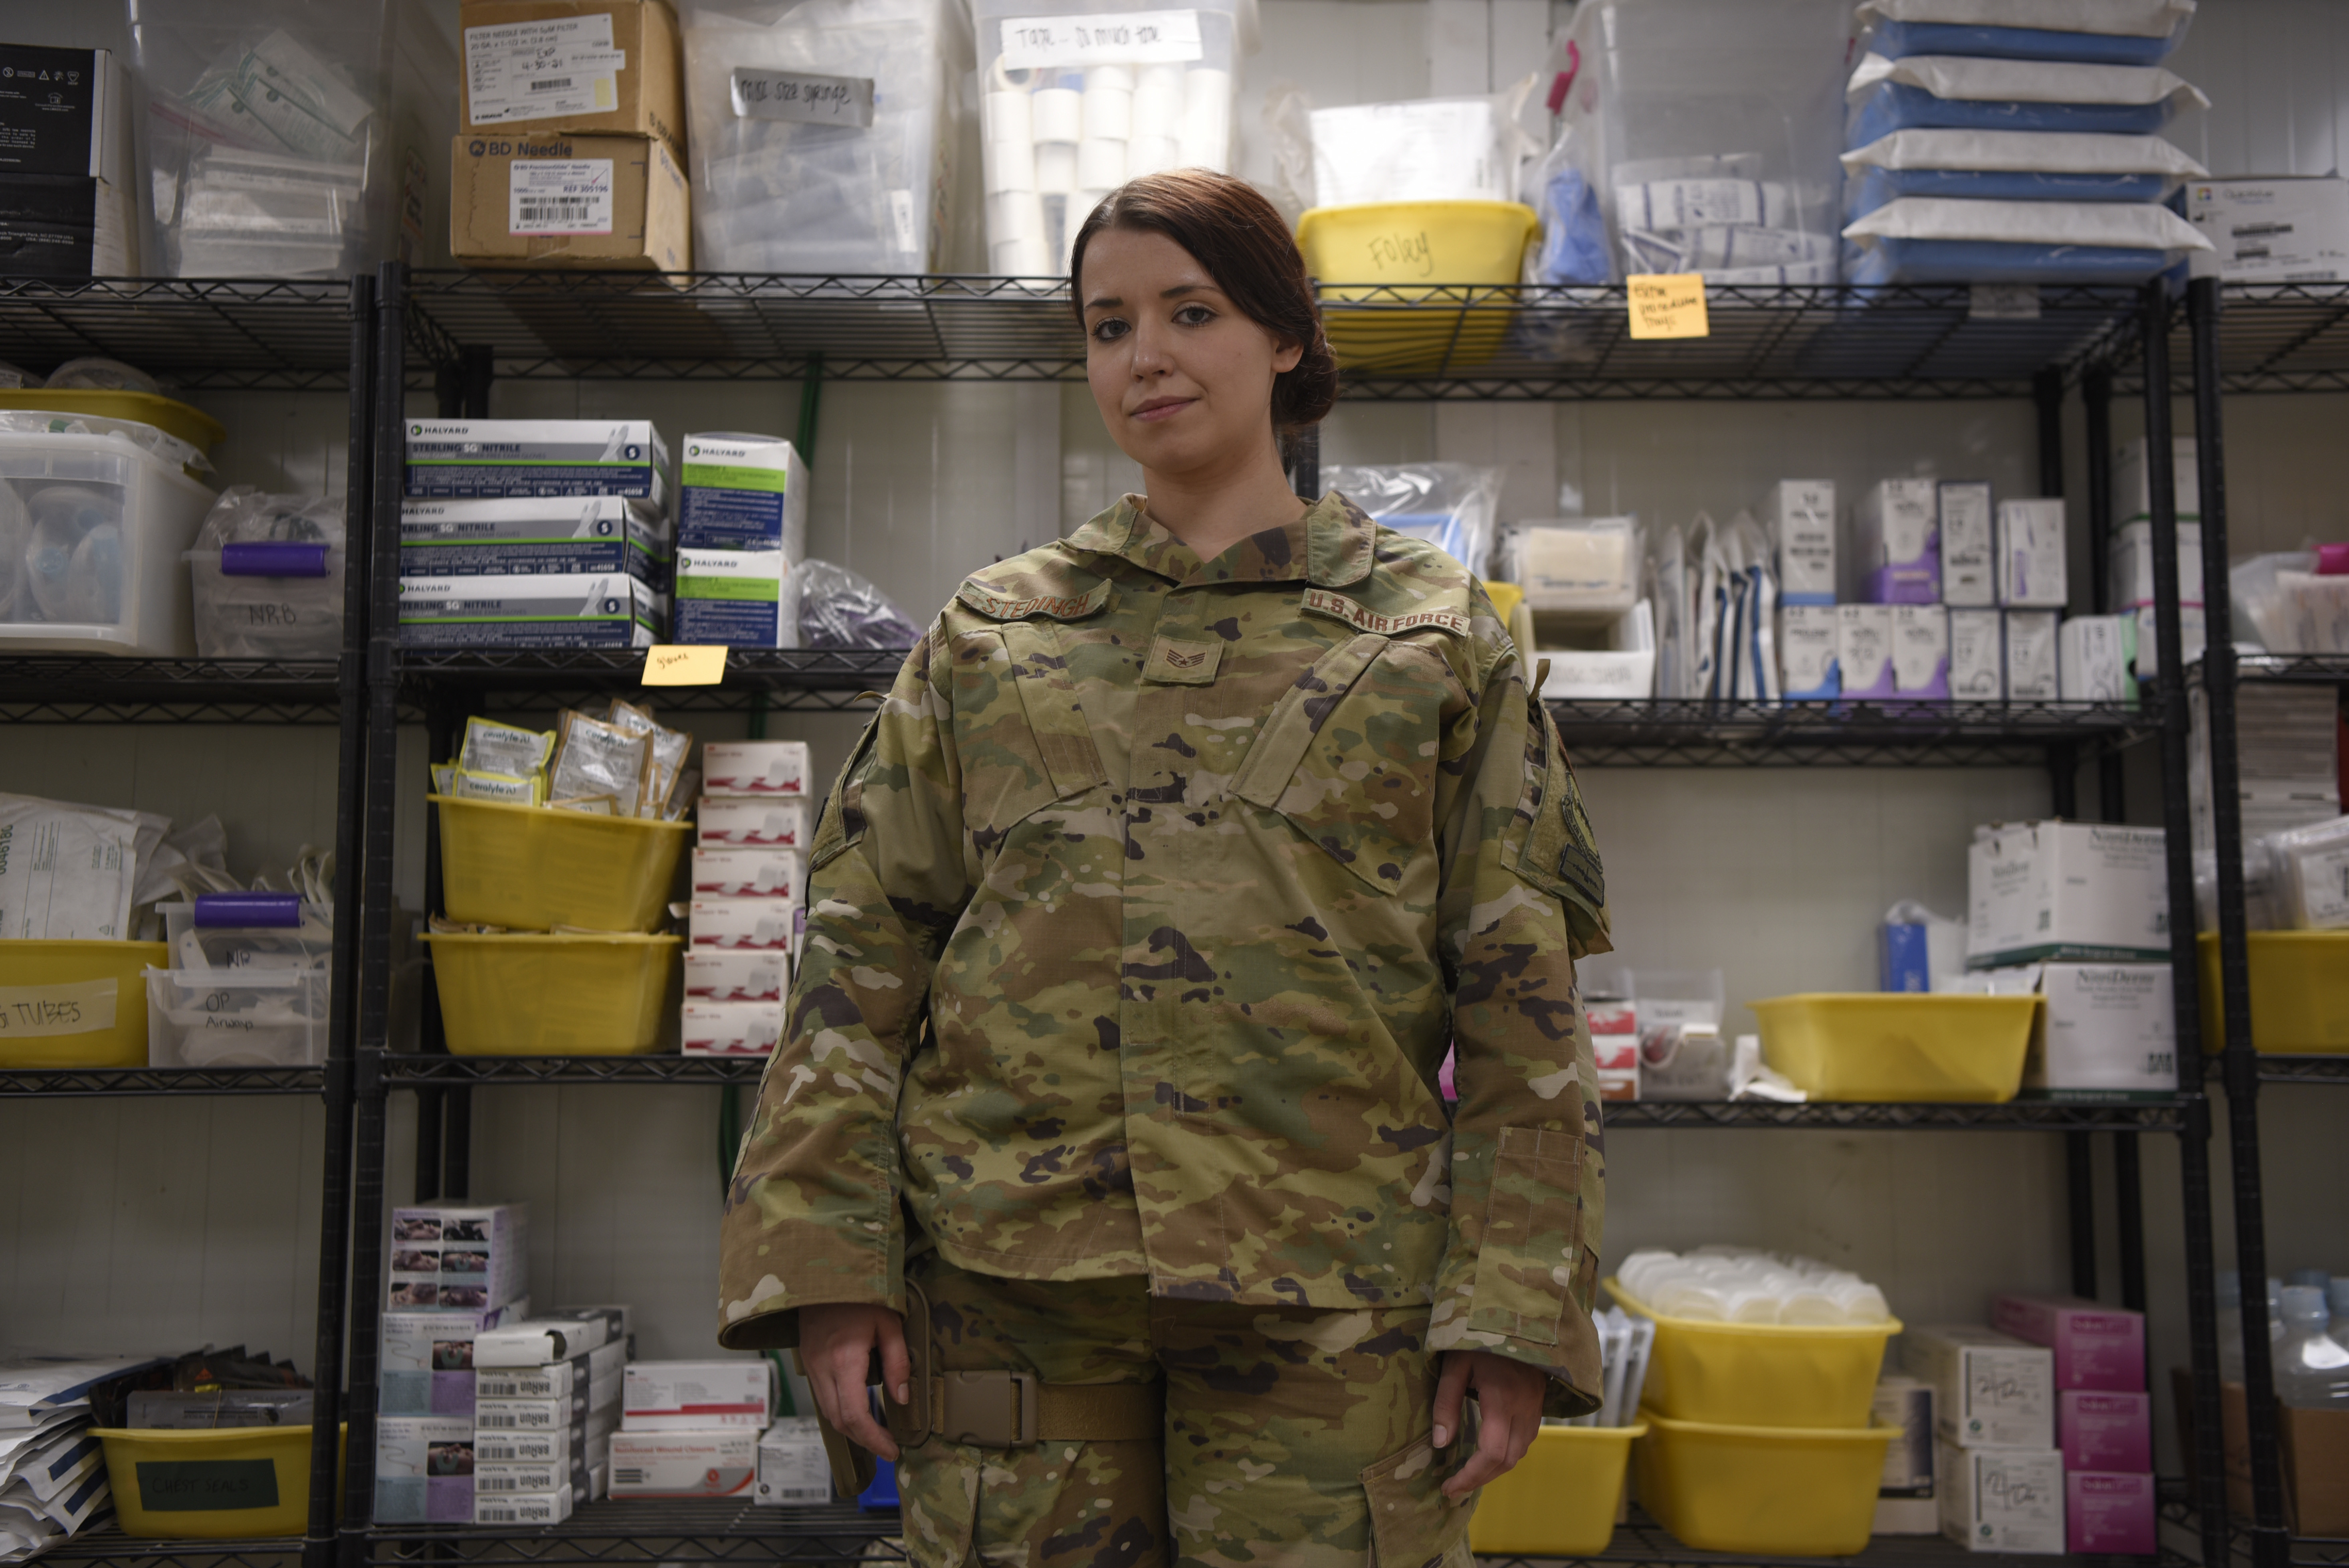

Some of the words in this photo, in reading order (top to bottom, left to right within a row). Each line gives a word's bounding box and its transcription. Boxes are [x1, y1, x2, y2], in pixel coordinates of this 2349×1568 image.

[470, 30, 491, 41] FILTER
[493, 28, 518, 39] NEEDLE
[521, 27, 538, 37] WITH
[557, 22, 578, 32] FILTER
[489, 142, 511, 156] BD
[518, 142, 573, 156] Needle
[1368, 230, 1433, 277] Foley
[412, 443, 461, 453] STERLING
[463, 443, 478, 453] SG
[482, 443, 521, 452] NITRILE
[702, 448, 745, 457] HALYARD
[402, 507, 445, 515] HALYARD
[440, 523, 454, 533] SG
[458, 523, 495, 532] NITRILE
[694, 560, 737, 568] HALYARD
[446, 600, 460, 611] SG
[464, 600, 502, 609] NITRILE
[982, 593, 1089, 619] STEDINGH
[1309, 591, 1348, 618] U.S.
[1353, 609, 1388, 632] AIR
[1392, 613, 1465, 631] FORCE
[249, 602, 296, 626] NRB
[483, 730, 518, 742] ceralyte
[470, 782, 505, 795] ceralyte
[226, 951, 250, 968] NP
[206, 992, 230, 1012] OP
[11, 1000, 81, 1026] TUBES
[206, 1016, 254, 1031] Airways
[520, 1381, 550, 1395] BRAUN
[520, 1413, 549, 1426] BRAUN
[519, 1444, 549, 1457] BRAUN
[152, 1478, 199, 1494] CHEST
[205, 1477, 249, 1493] SEALS
[520, 1475, 550, 1489] BRAUN
[520, 1506, 550, 1520] BRAUN
